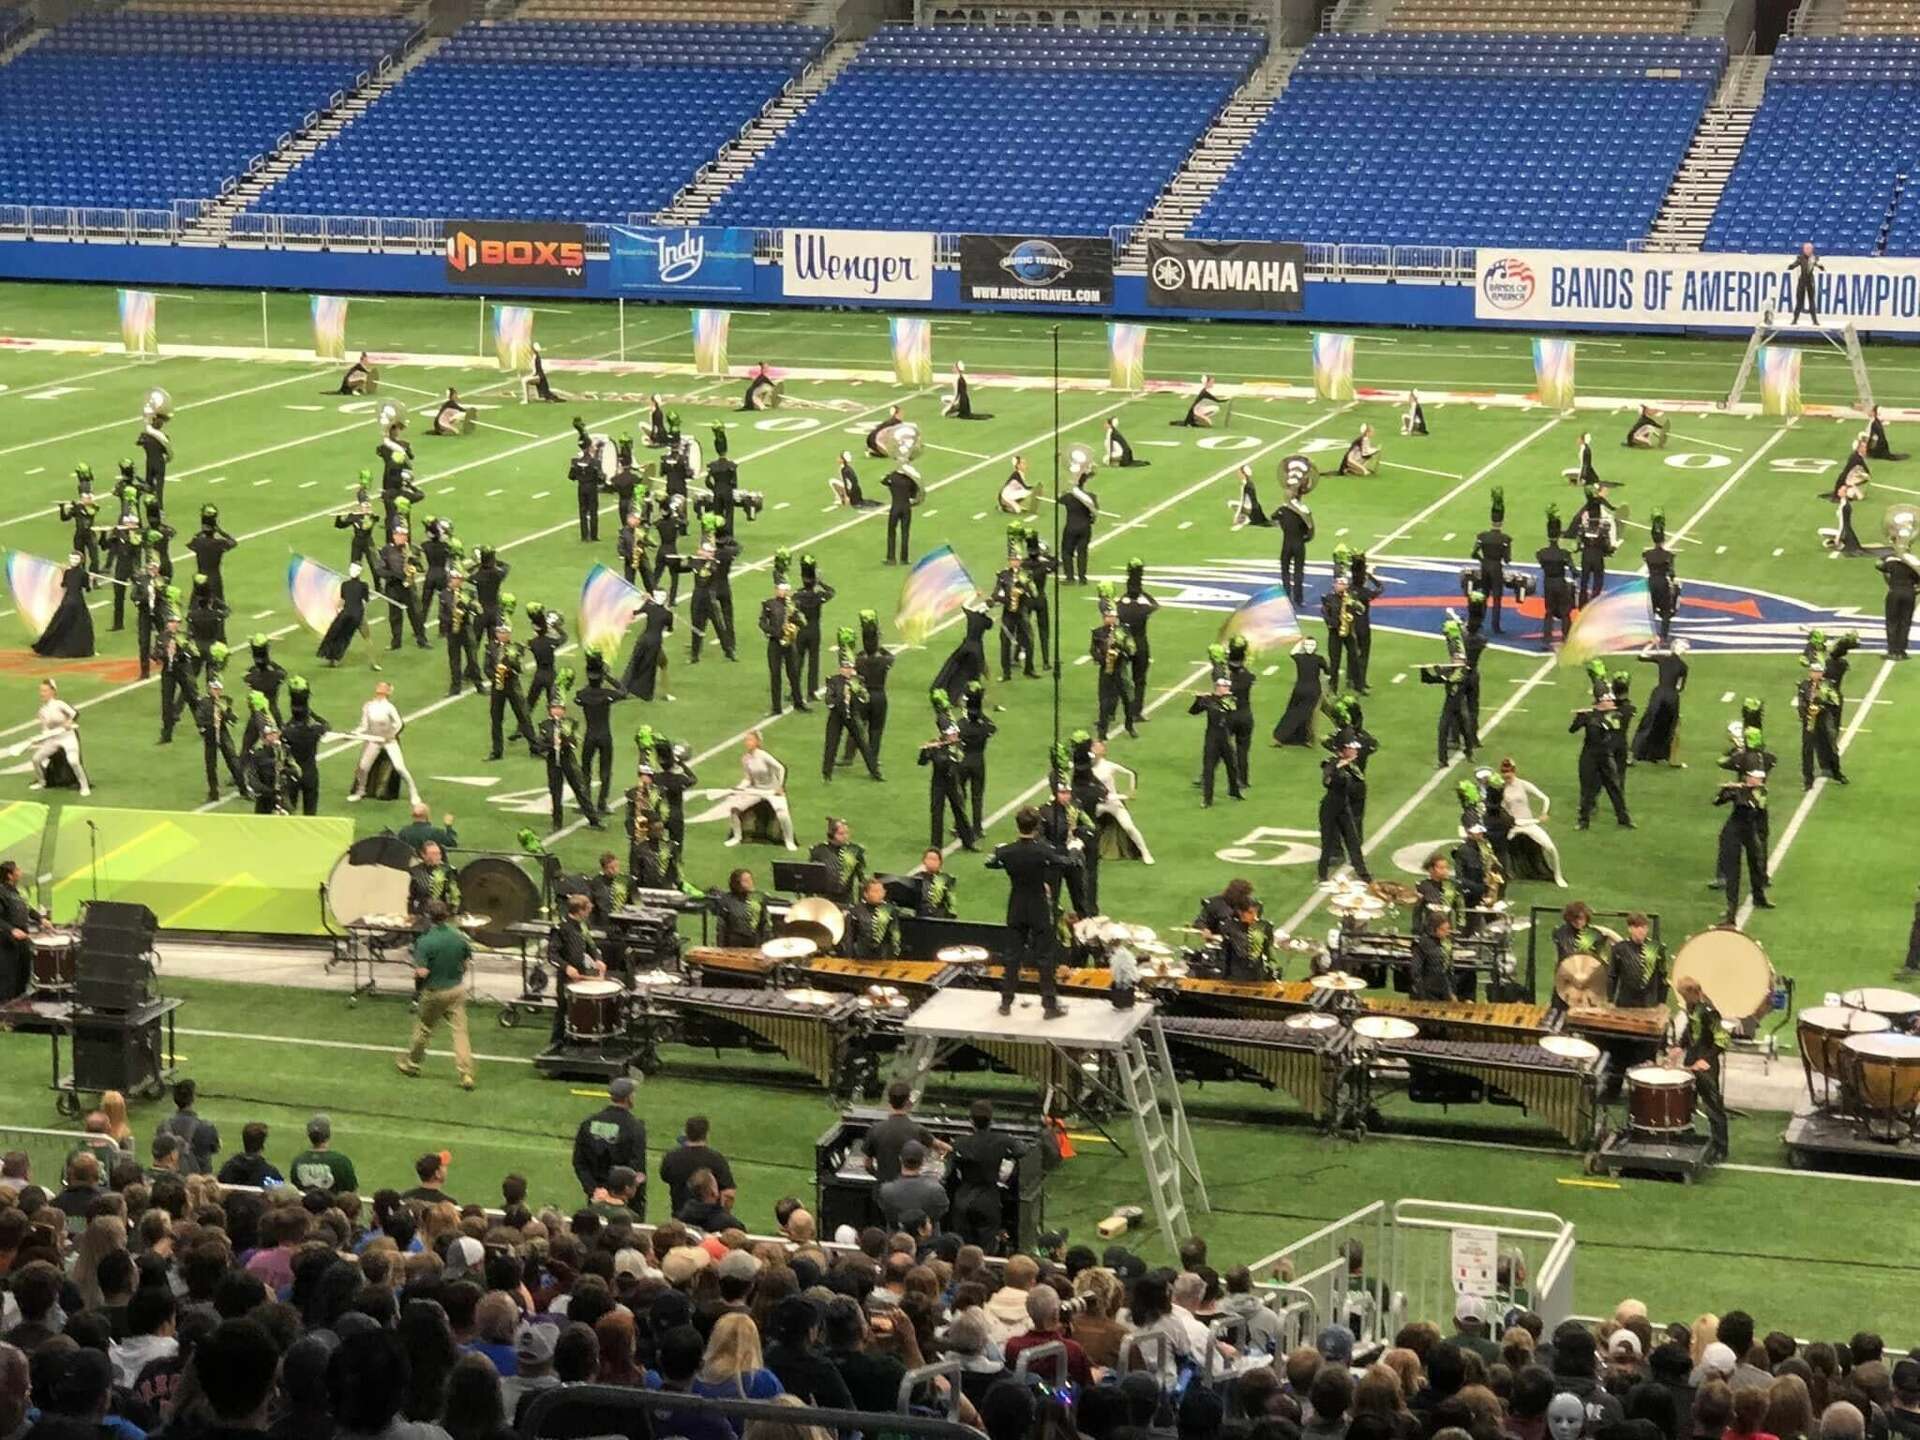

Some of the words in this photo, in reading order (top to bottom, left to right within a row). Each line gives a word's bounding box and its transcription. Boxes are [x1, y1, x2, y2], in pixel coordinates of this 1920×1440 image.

[658, 228, 704, 283] Indy
[794, 233, 920, 295] Wenger
[1003, 256, 1034, 266] MUSIC
[1034, 256, 1069, 269] TRAVEL
[565, 267, 582, 277] TV
[1187, 259, 1298, 293] YAMAHA
[971, 285, 1101, 303] WWW.MUSICTRAVEL.COM
[1488, 283, 1515, 293] BANDS
[1516, 284, 1528, 292] OF
[1491, 292, 1526, 301] AMERICA
[1551, 266, 1634, 310] BANDS
[1644, 269, 1673, 312] OF
[1682, 270, 1793, 314] AMERICA
[1799, 272, 1920, 318] HAMPIO
